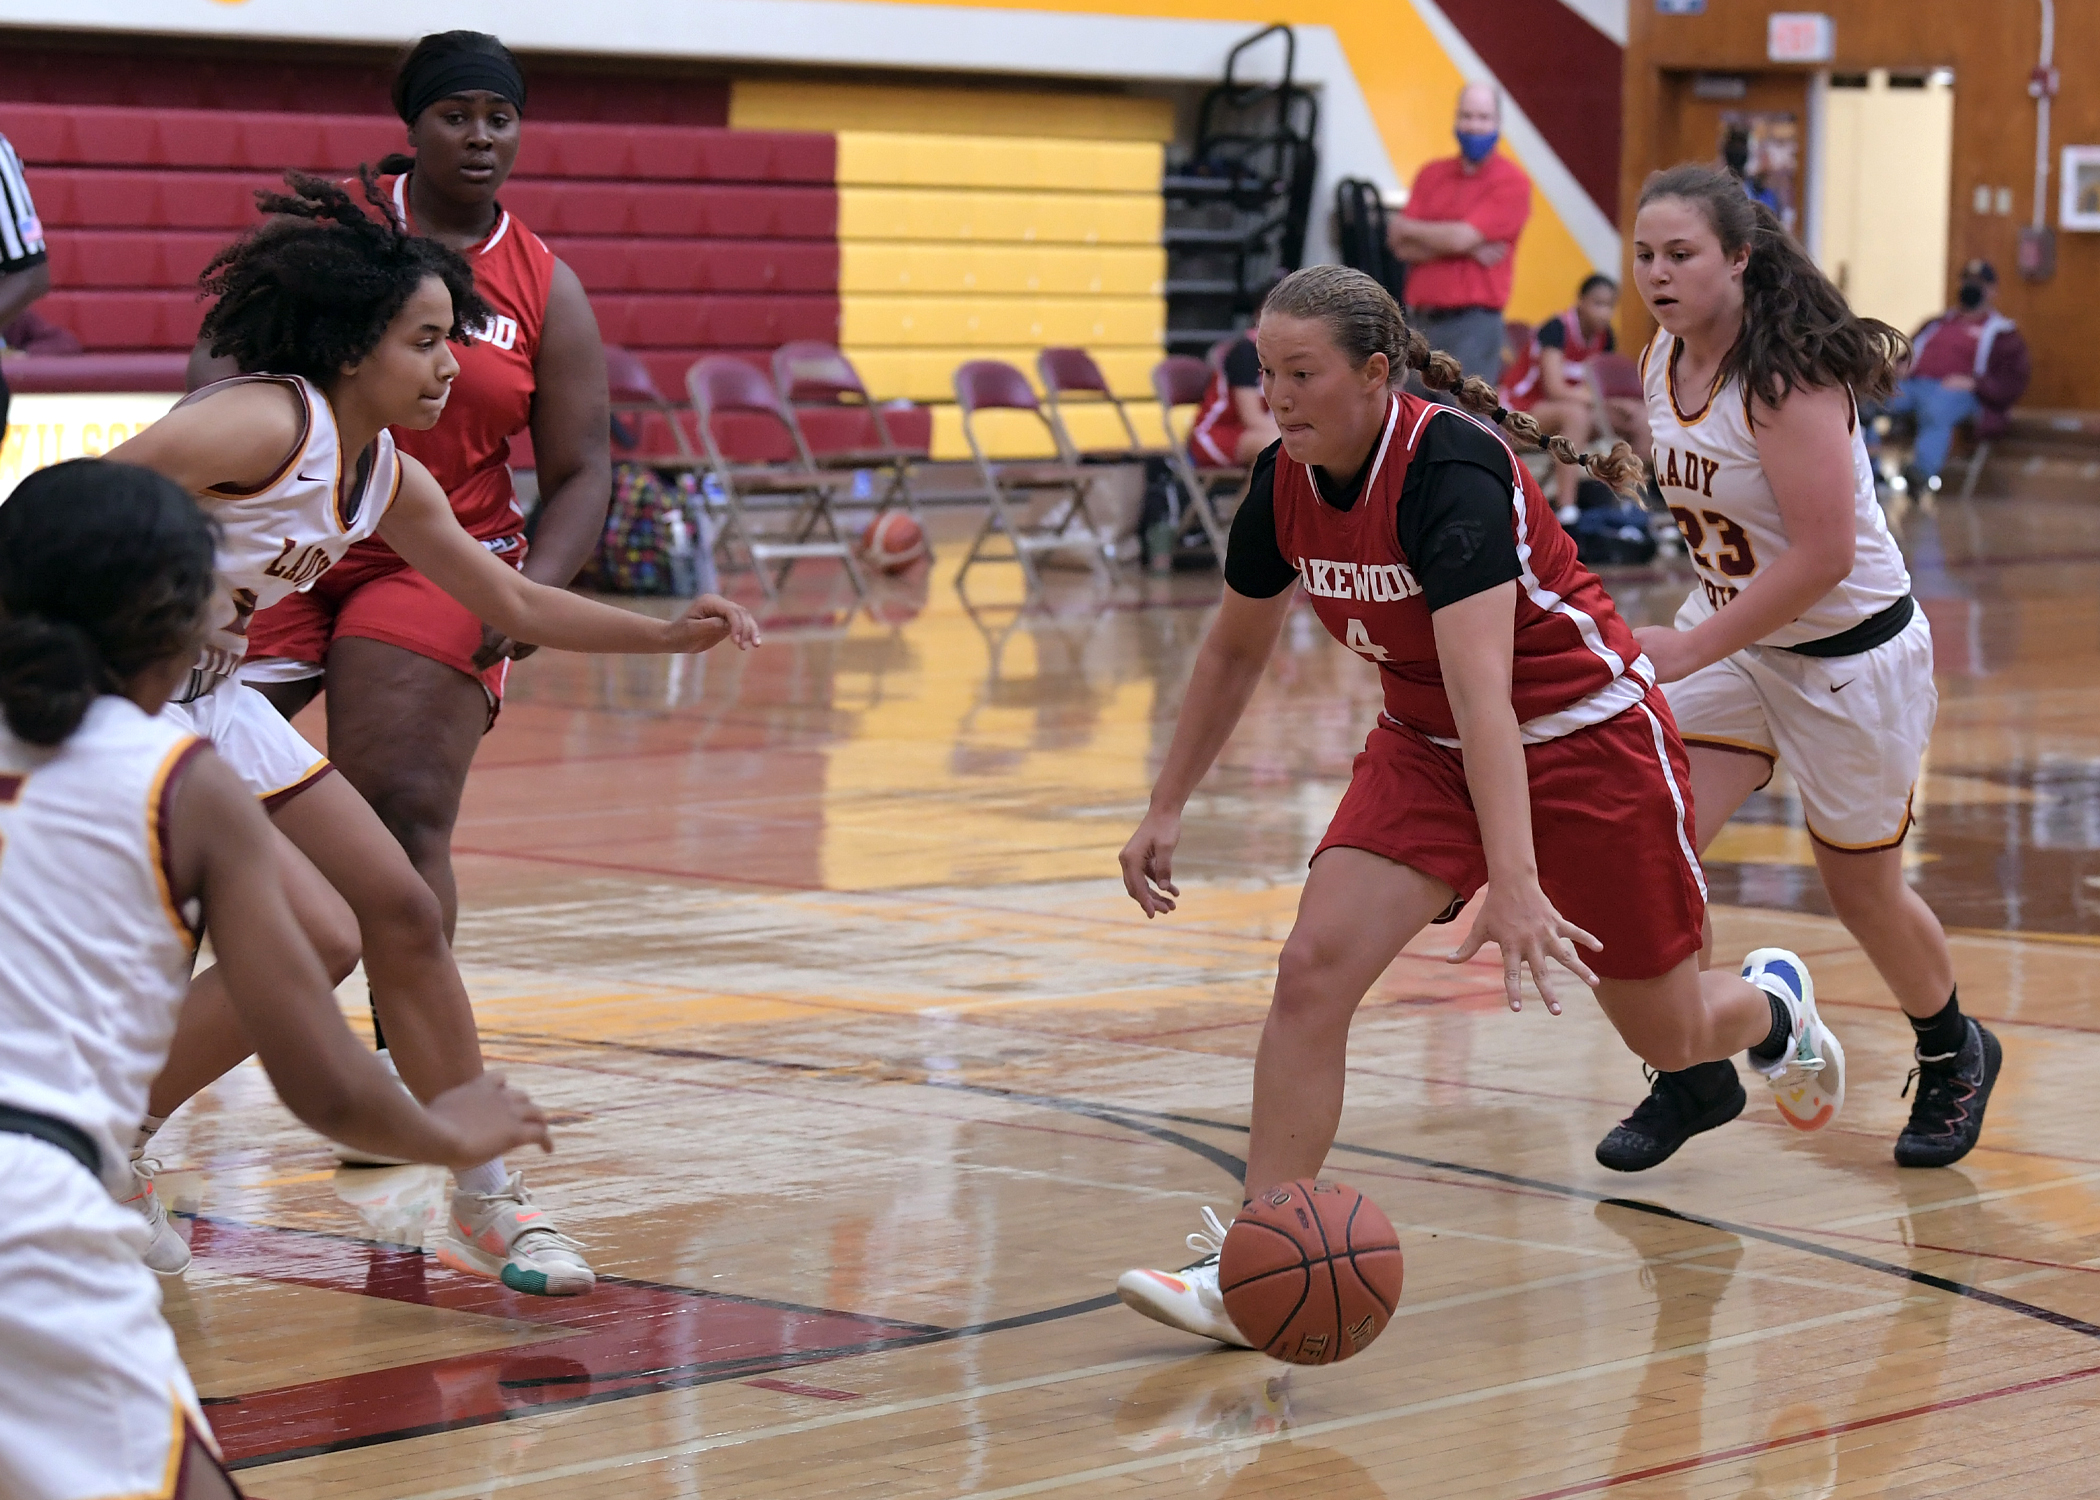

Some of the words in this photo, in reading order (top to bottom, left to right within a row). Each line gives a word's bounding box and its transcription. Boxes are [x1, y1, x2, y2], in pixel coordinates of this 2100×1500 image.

[0, 423, 156, 481] WILSO
[1653, 447, 1720, 499] LADY
[1668, 503, 1759, 580] 23
[1293, 556, 1424, 603] AKEWOO
[1345, 618, 1397, 662] 4
